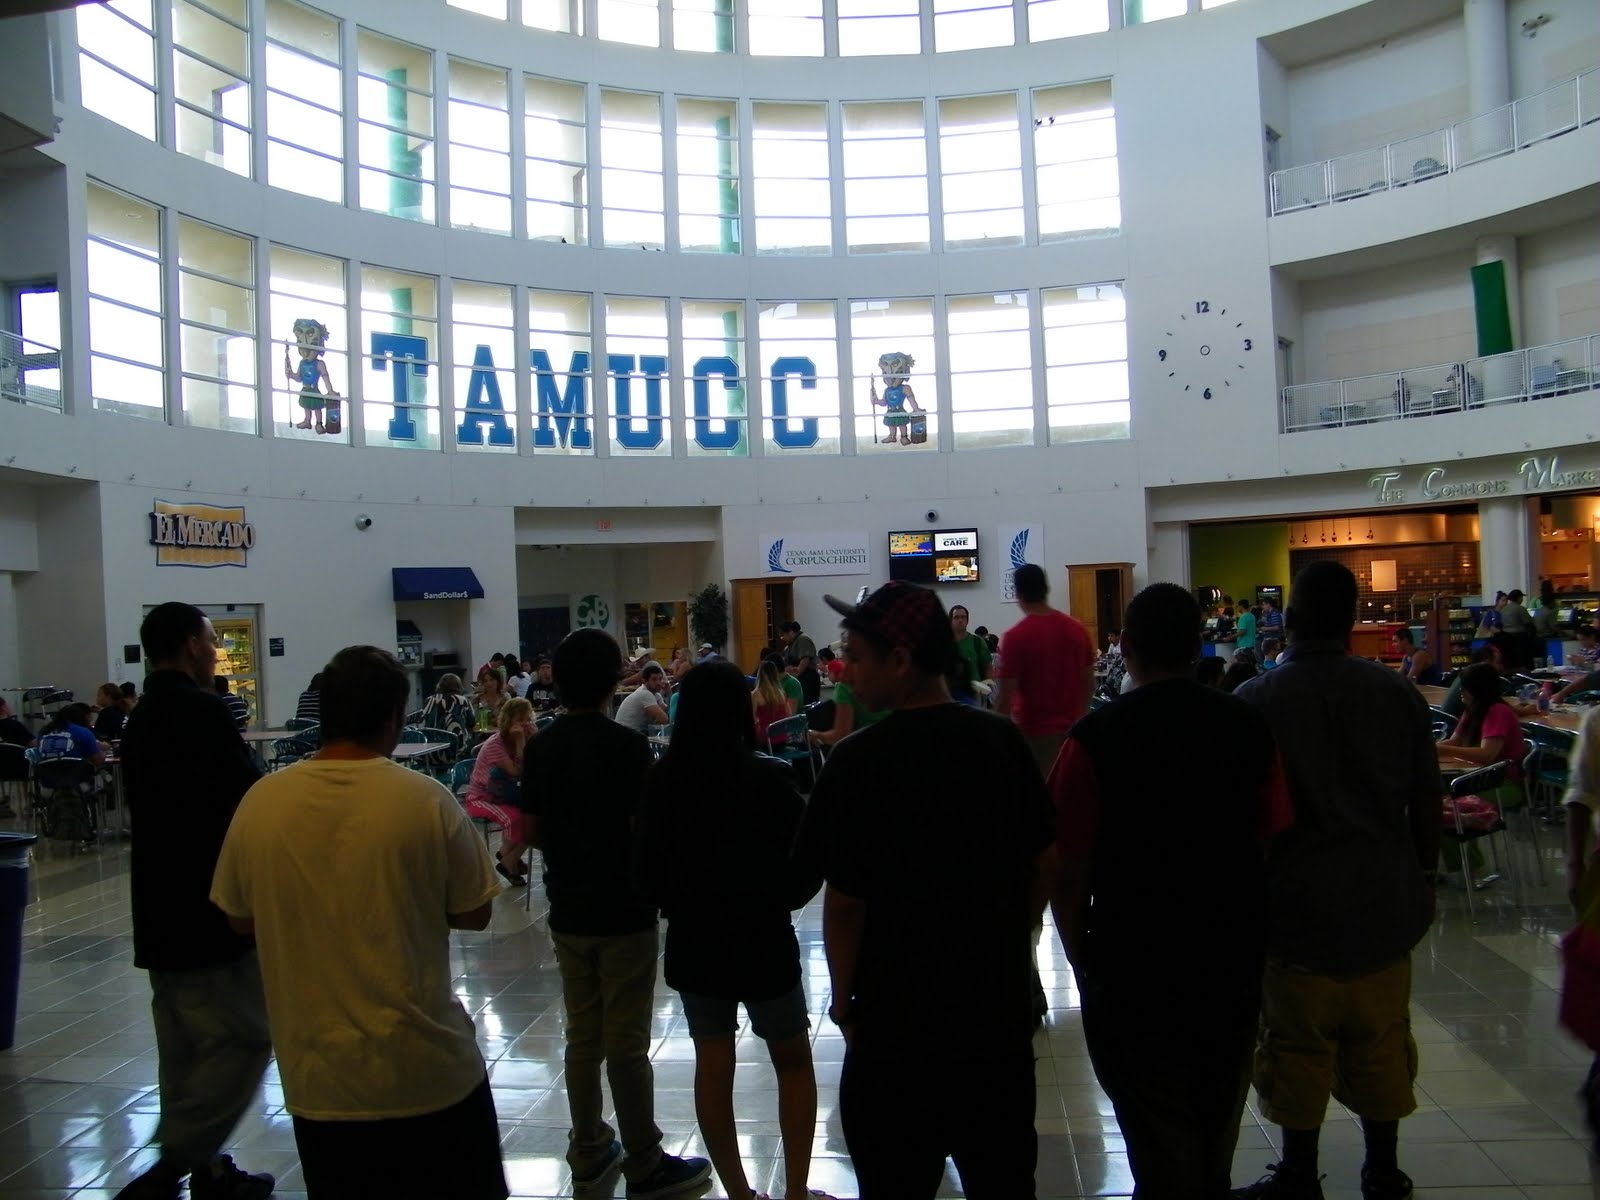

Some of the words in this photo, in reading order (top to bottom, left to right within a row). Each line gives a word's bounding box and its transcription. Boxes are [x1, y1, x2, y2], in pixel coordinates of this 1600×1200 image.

[1196, 301, 1210, 314] 12
[1244, 339, 1252, 351] 3
[1158, 349, 1167, 361] 9
[371, 332, 820, 450] TAMUCC
[1203, 388, 1212, 400] 6
[1422, 467, 1509, 499] COMMONS
[1518, 456, 1600, 490] MARKE
[176, 515, 256, 549] MERCADO
[943, 539, 969, 547] CARE
[825, 548, 866, 556] UNIVERSITY
[785, 556, 826, 566] CORPUS
[826, 554, 867, 565] CHRISTI
[423, 591, 469, 599] SandDollar$
